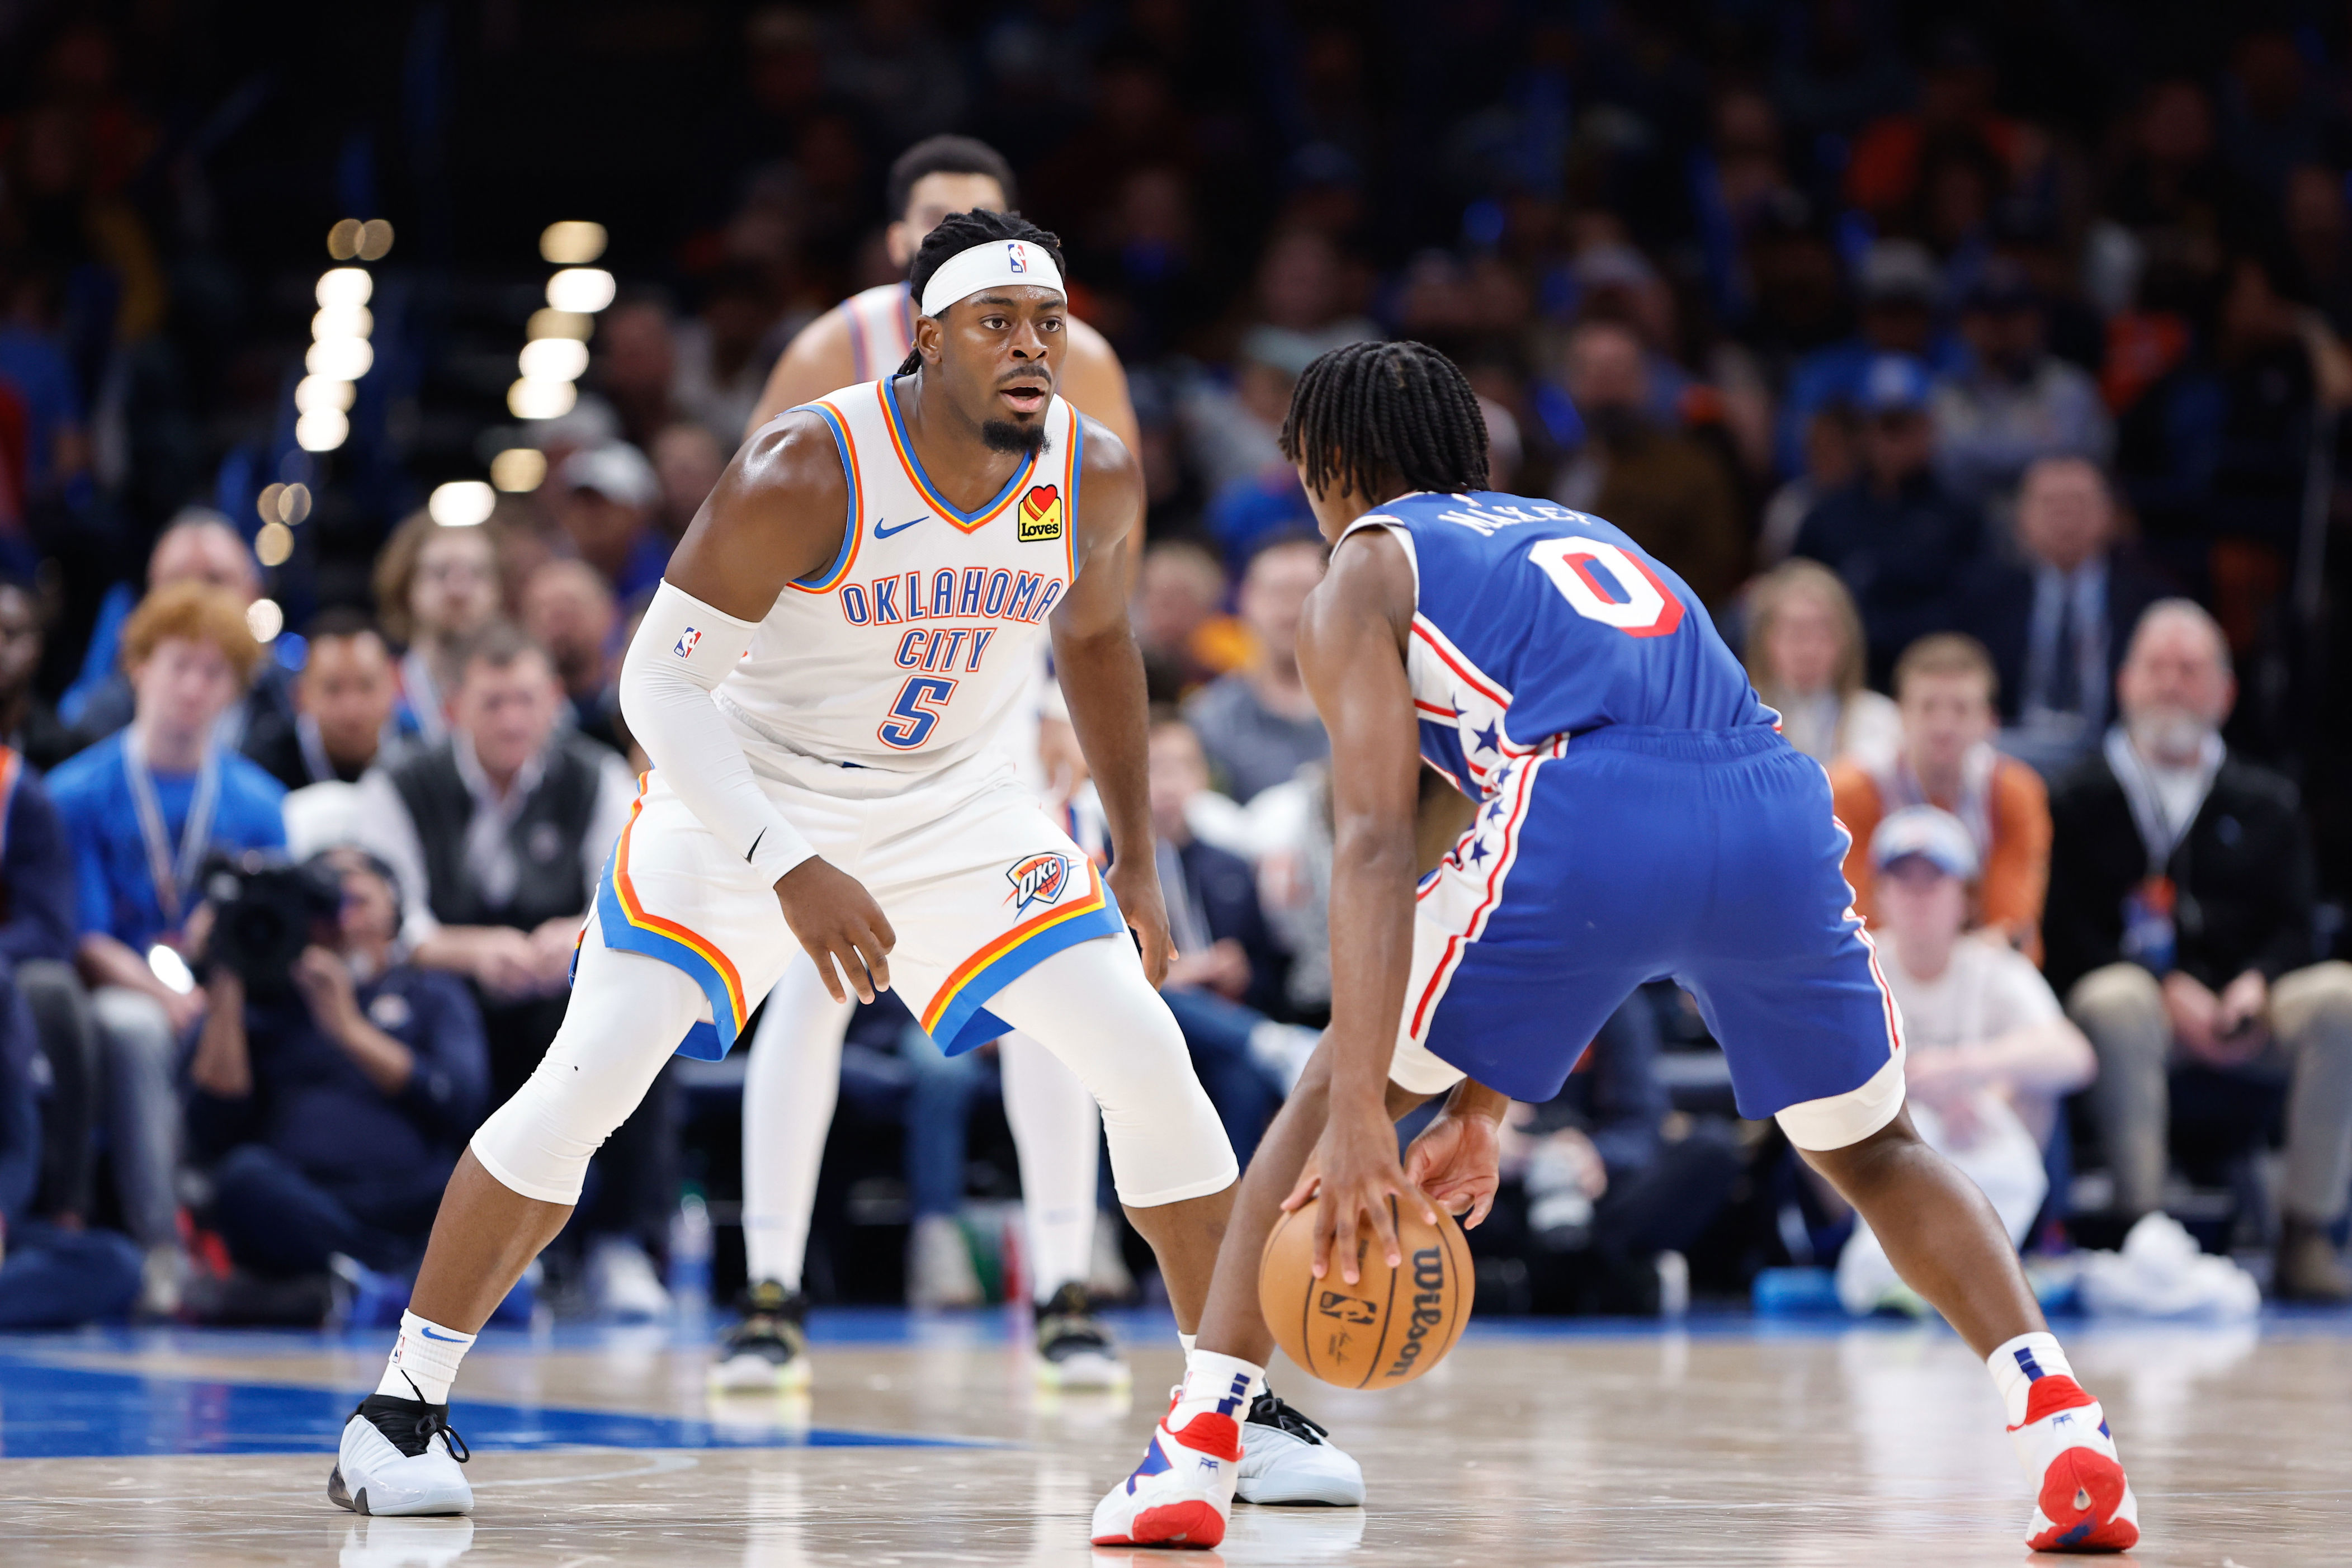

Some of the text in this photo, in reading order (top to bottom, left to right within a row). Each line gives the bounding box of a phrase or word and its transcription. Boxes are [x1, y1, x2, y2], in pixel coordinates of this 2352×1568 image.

[839, 566, 1063, 626] OKLAHOMA
[1528, 536, 1685, 638] 0
[894, 627, 998, 672] CITY
[877, 674, 960, 750] 5
[1017, 857, 1058, 909] OKC
